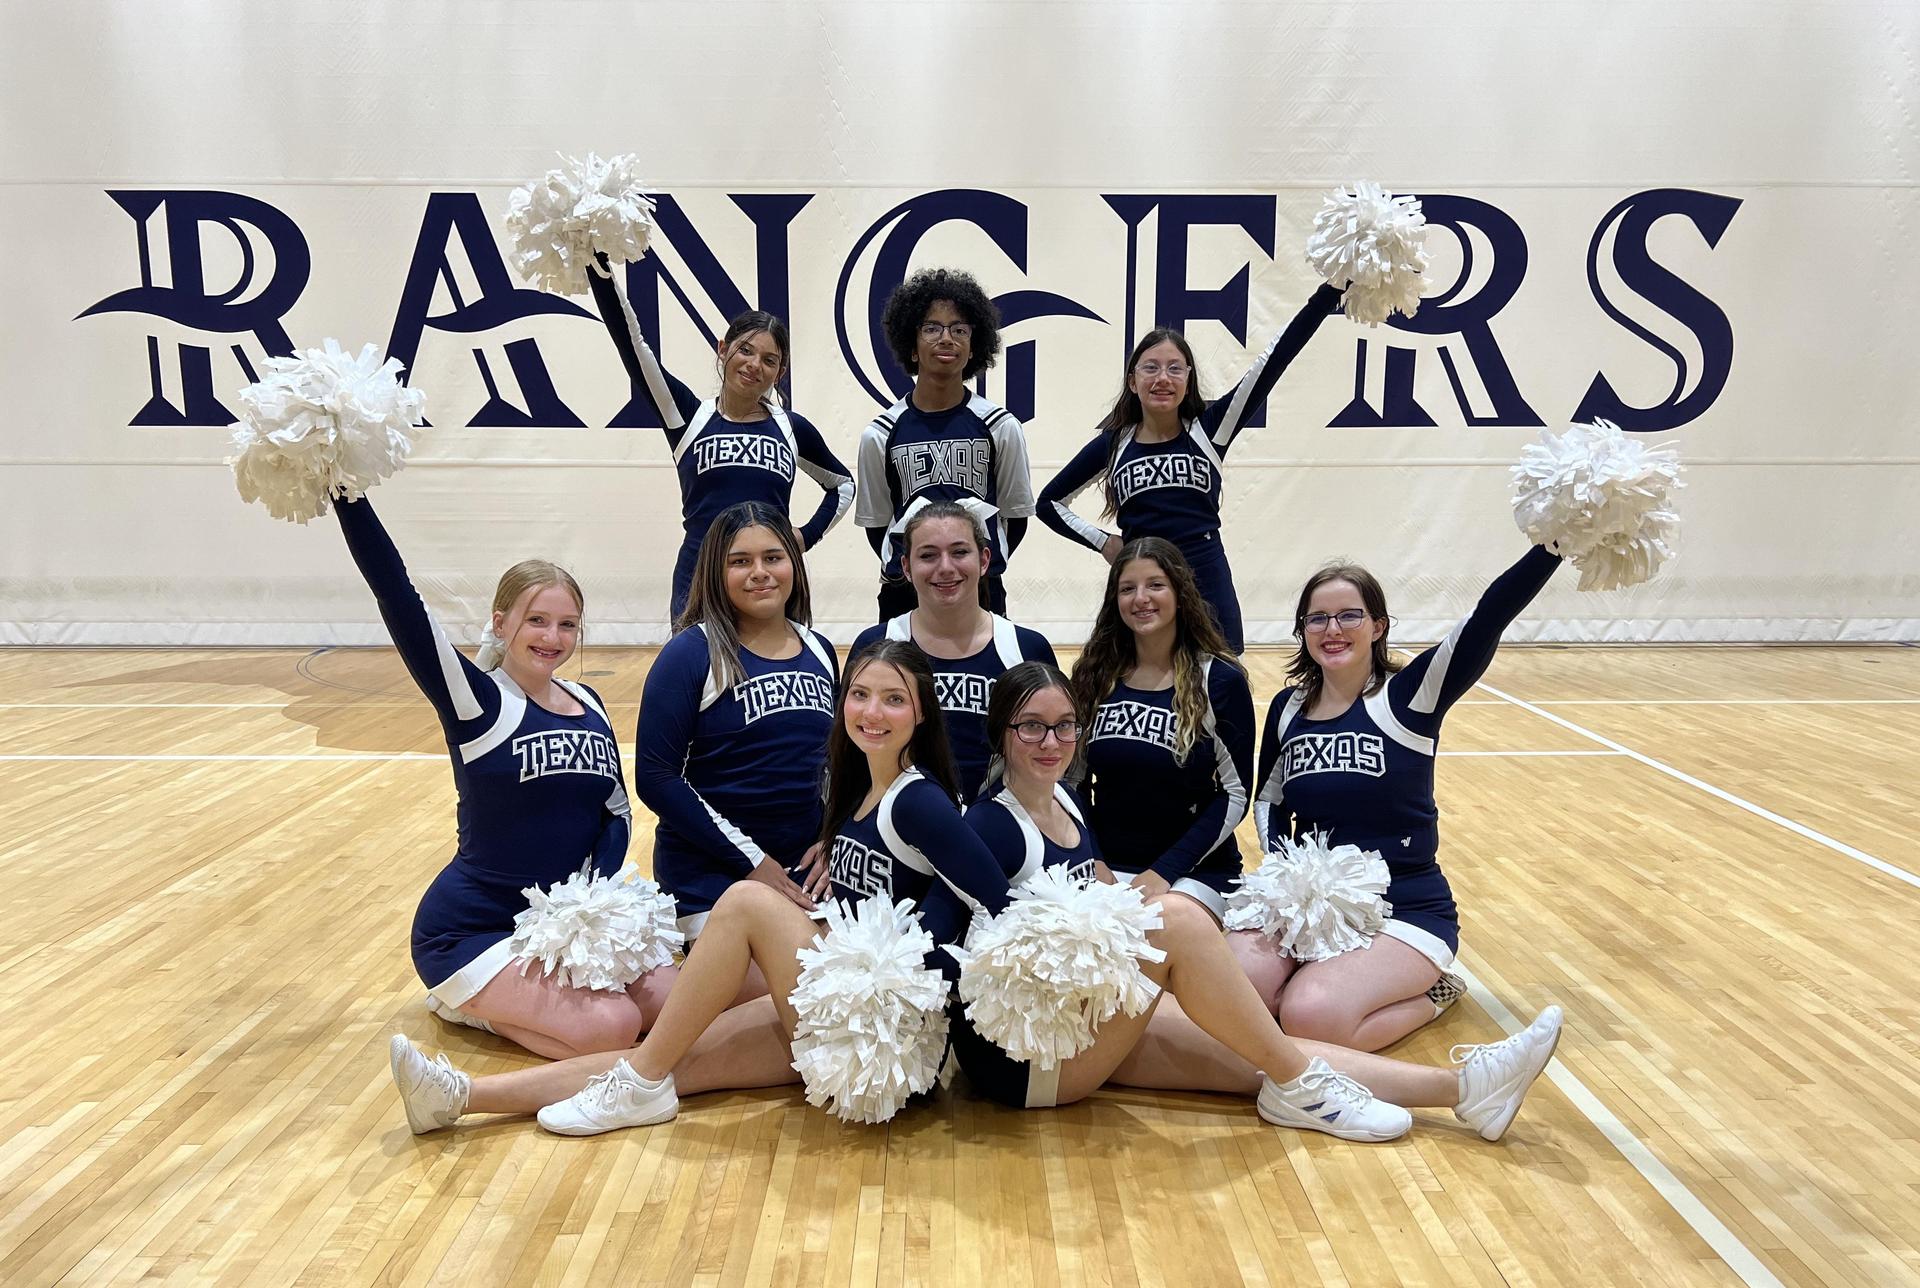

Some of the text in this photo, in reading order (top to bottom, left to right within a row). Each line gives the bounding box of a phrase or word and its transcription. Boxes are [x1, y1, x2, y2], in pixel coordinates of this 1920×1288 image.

[74, 189, 1743, 431] RANGERS
[693, 433, 793, 482] TEXAS
[890, 438, 991, 507] TEXAS
[1113, 454, 1212, 506] TEXAS
[733, 670, 834, 725] TEXAS
[829, 834, 894, 898] XAS
